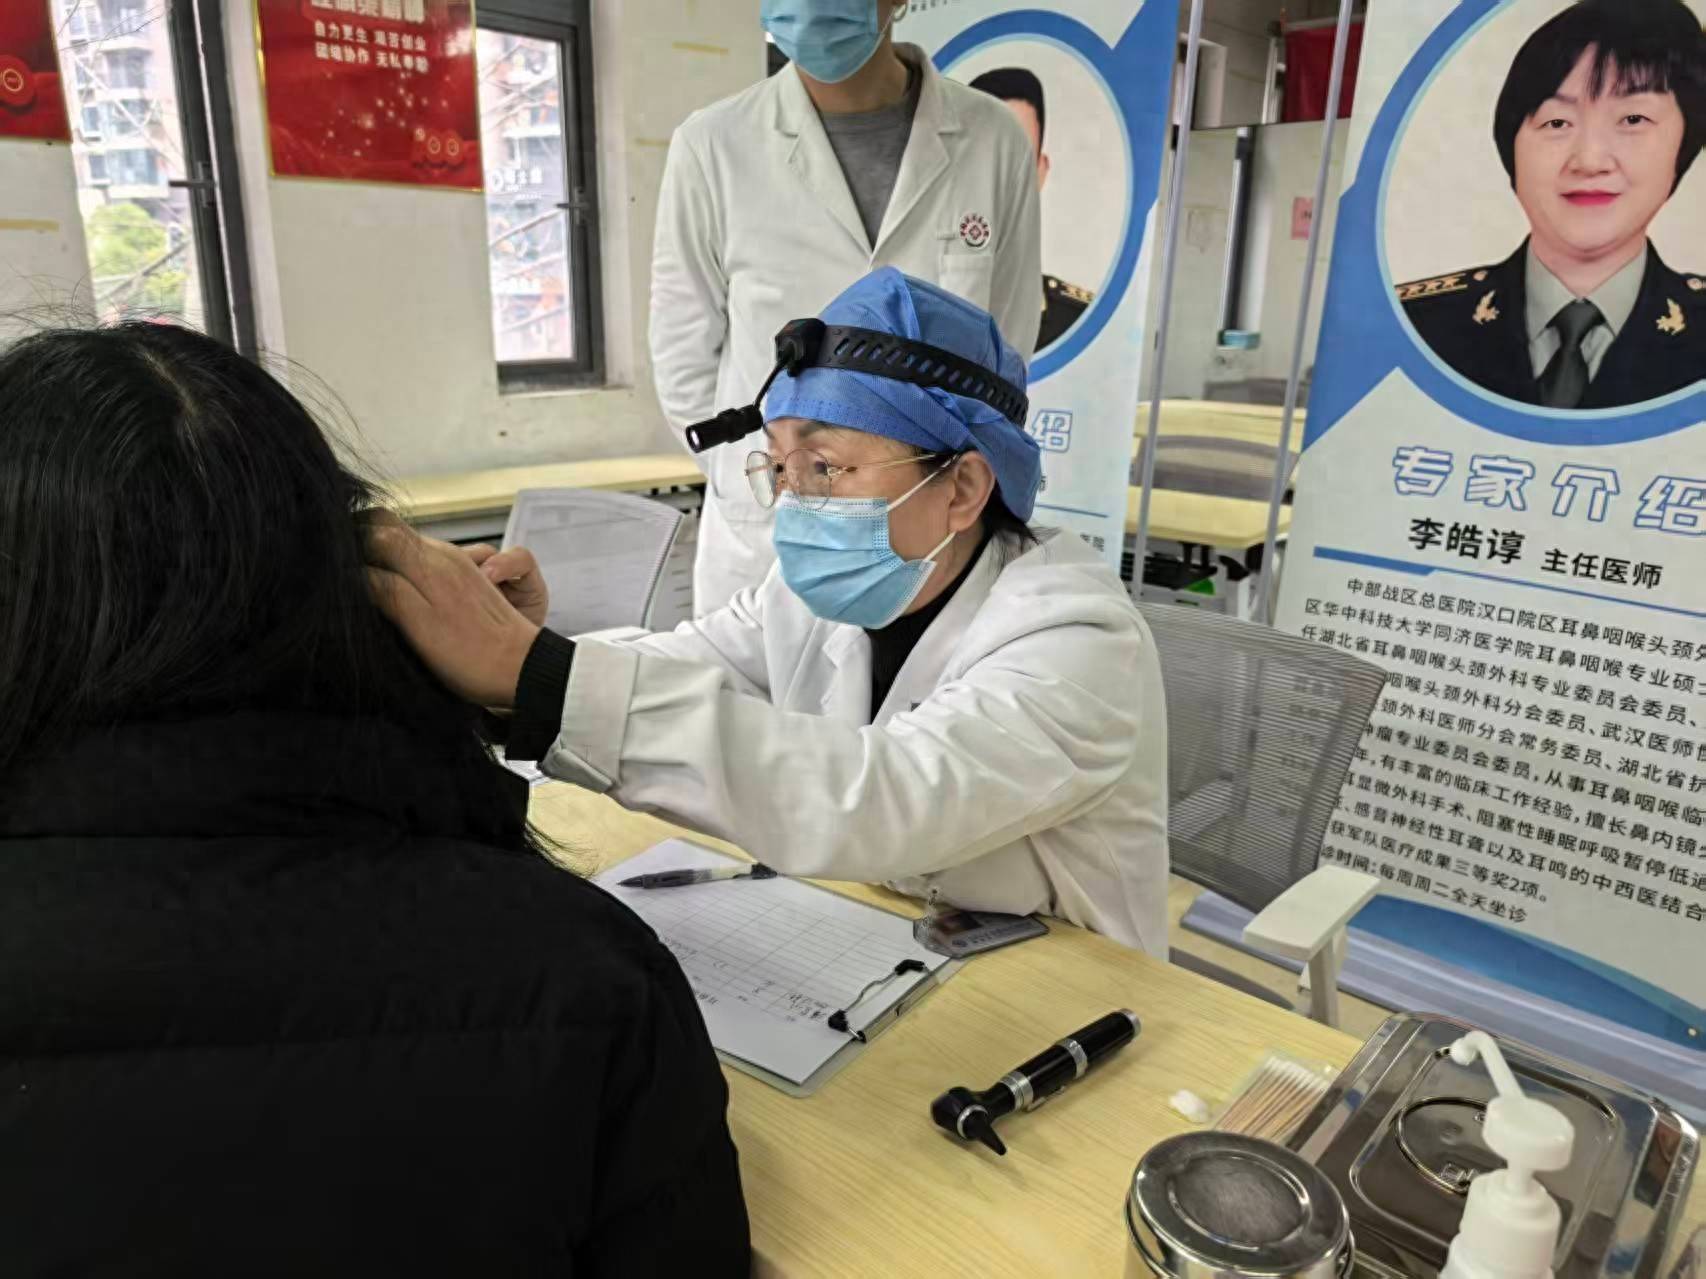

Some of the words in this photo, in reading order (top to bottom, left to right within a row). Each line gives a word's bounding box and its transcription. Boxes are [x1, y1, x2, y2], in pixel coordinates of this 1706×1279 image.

[1391, 446, 1706, 536] 专家介绍
[1407, 516, 1526, 564] 李皓谆
[1540, 547, 1664, 589] 主任医师
[1353, 747, 1706, 858] 年，有丰富的临床工作经验，擅长鼻内镜
